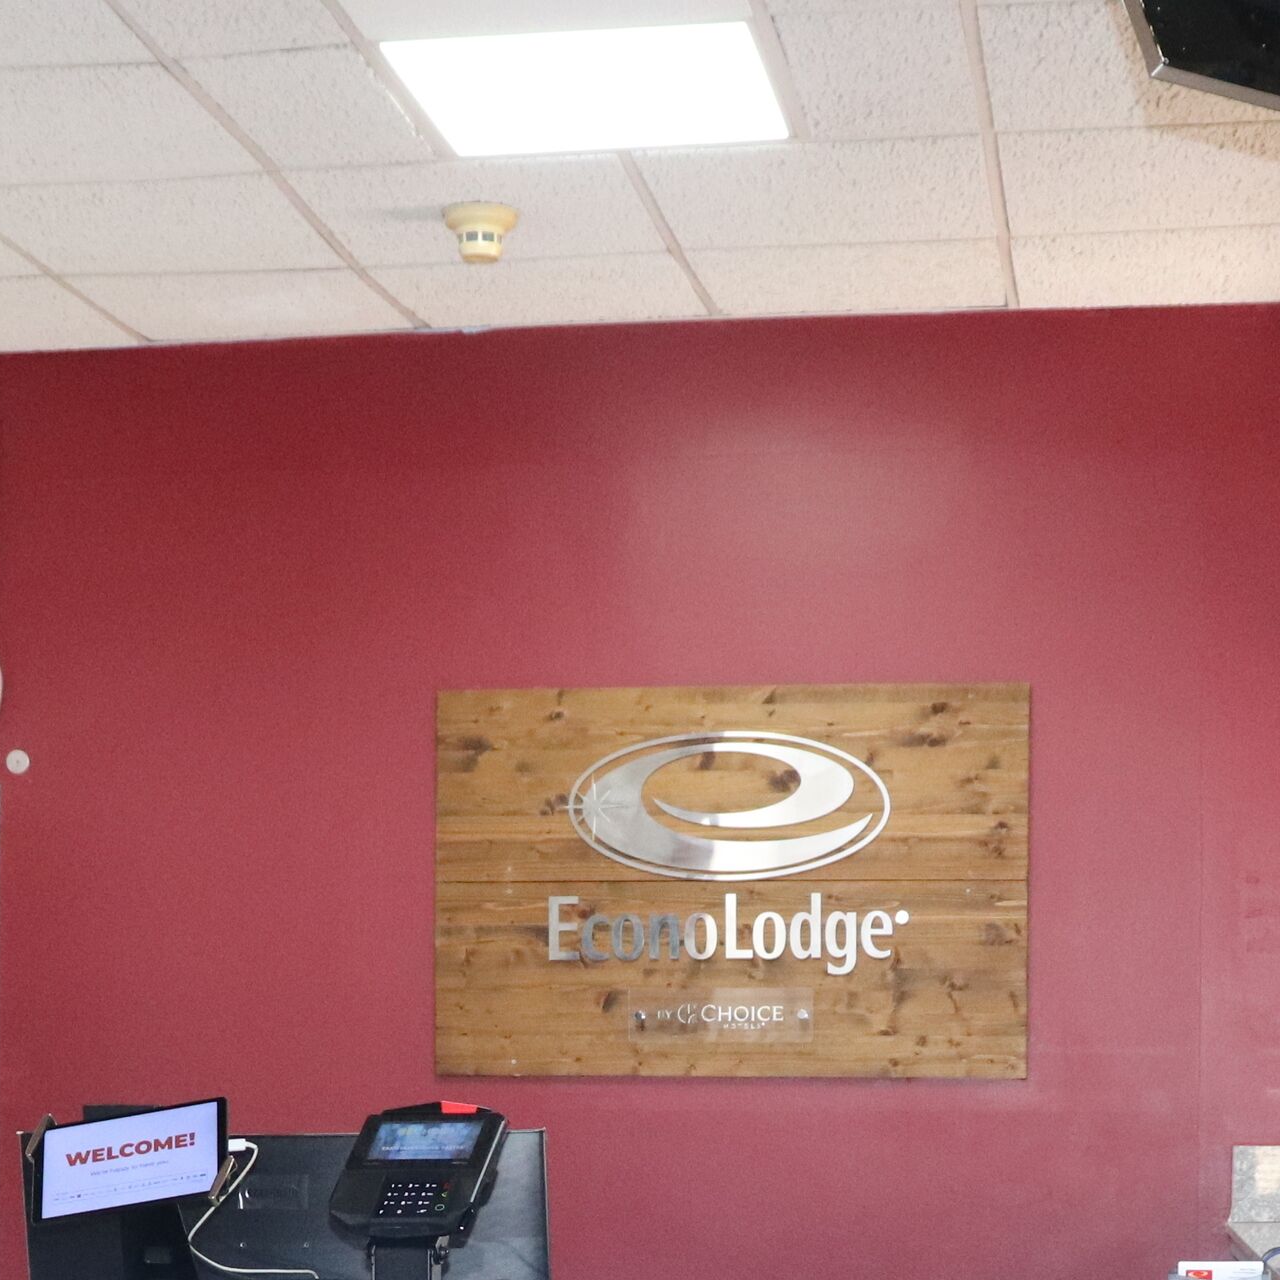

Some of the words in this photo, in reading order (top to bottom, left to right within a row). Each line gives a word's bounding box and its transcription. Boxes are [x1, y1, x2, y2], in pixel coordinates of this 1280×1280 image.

[548, 893, 895, 976] EconoLodge
[701, 1004, 784, 1022] CHOICE
[65, 1132, 196, 1167] WELCOME!
